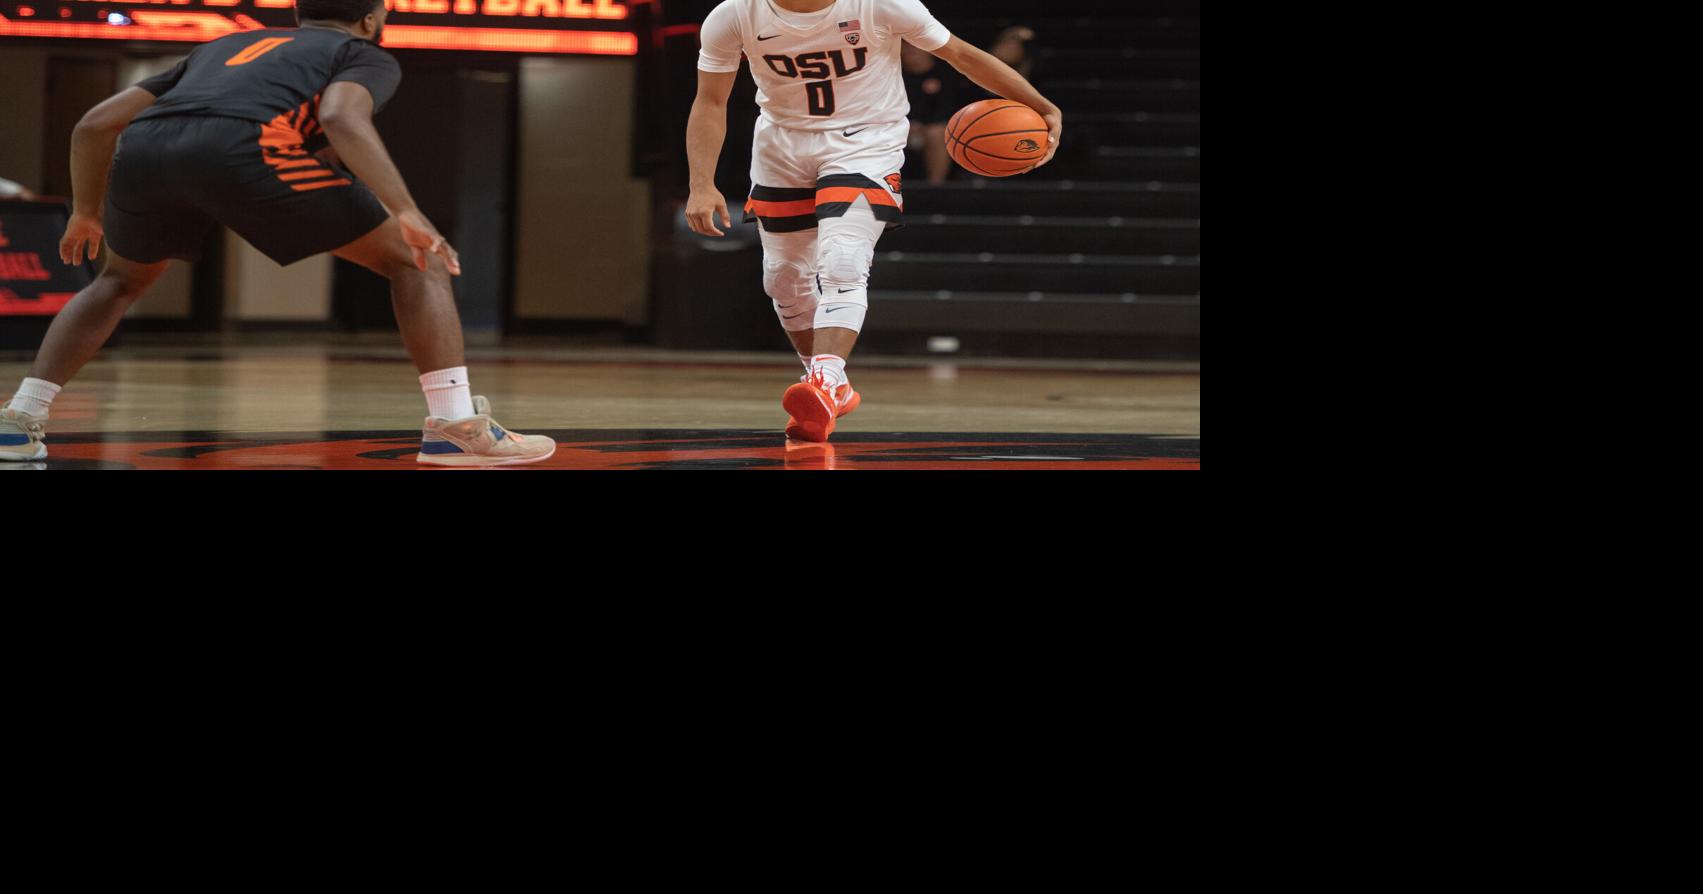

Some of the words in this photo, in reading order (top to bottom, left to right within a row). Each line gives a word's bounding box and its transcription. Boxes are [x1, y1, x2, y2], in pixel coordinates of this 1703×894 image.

[224, 37, 295, 66] 0
[762, 47, 868, 79] OSU
[805, 80, 835, 116] 0
